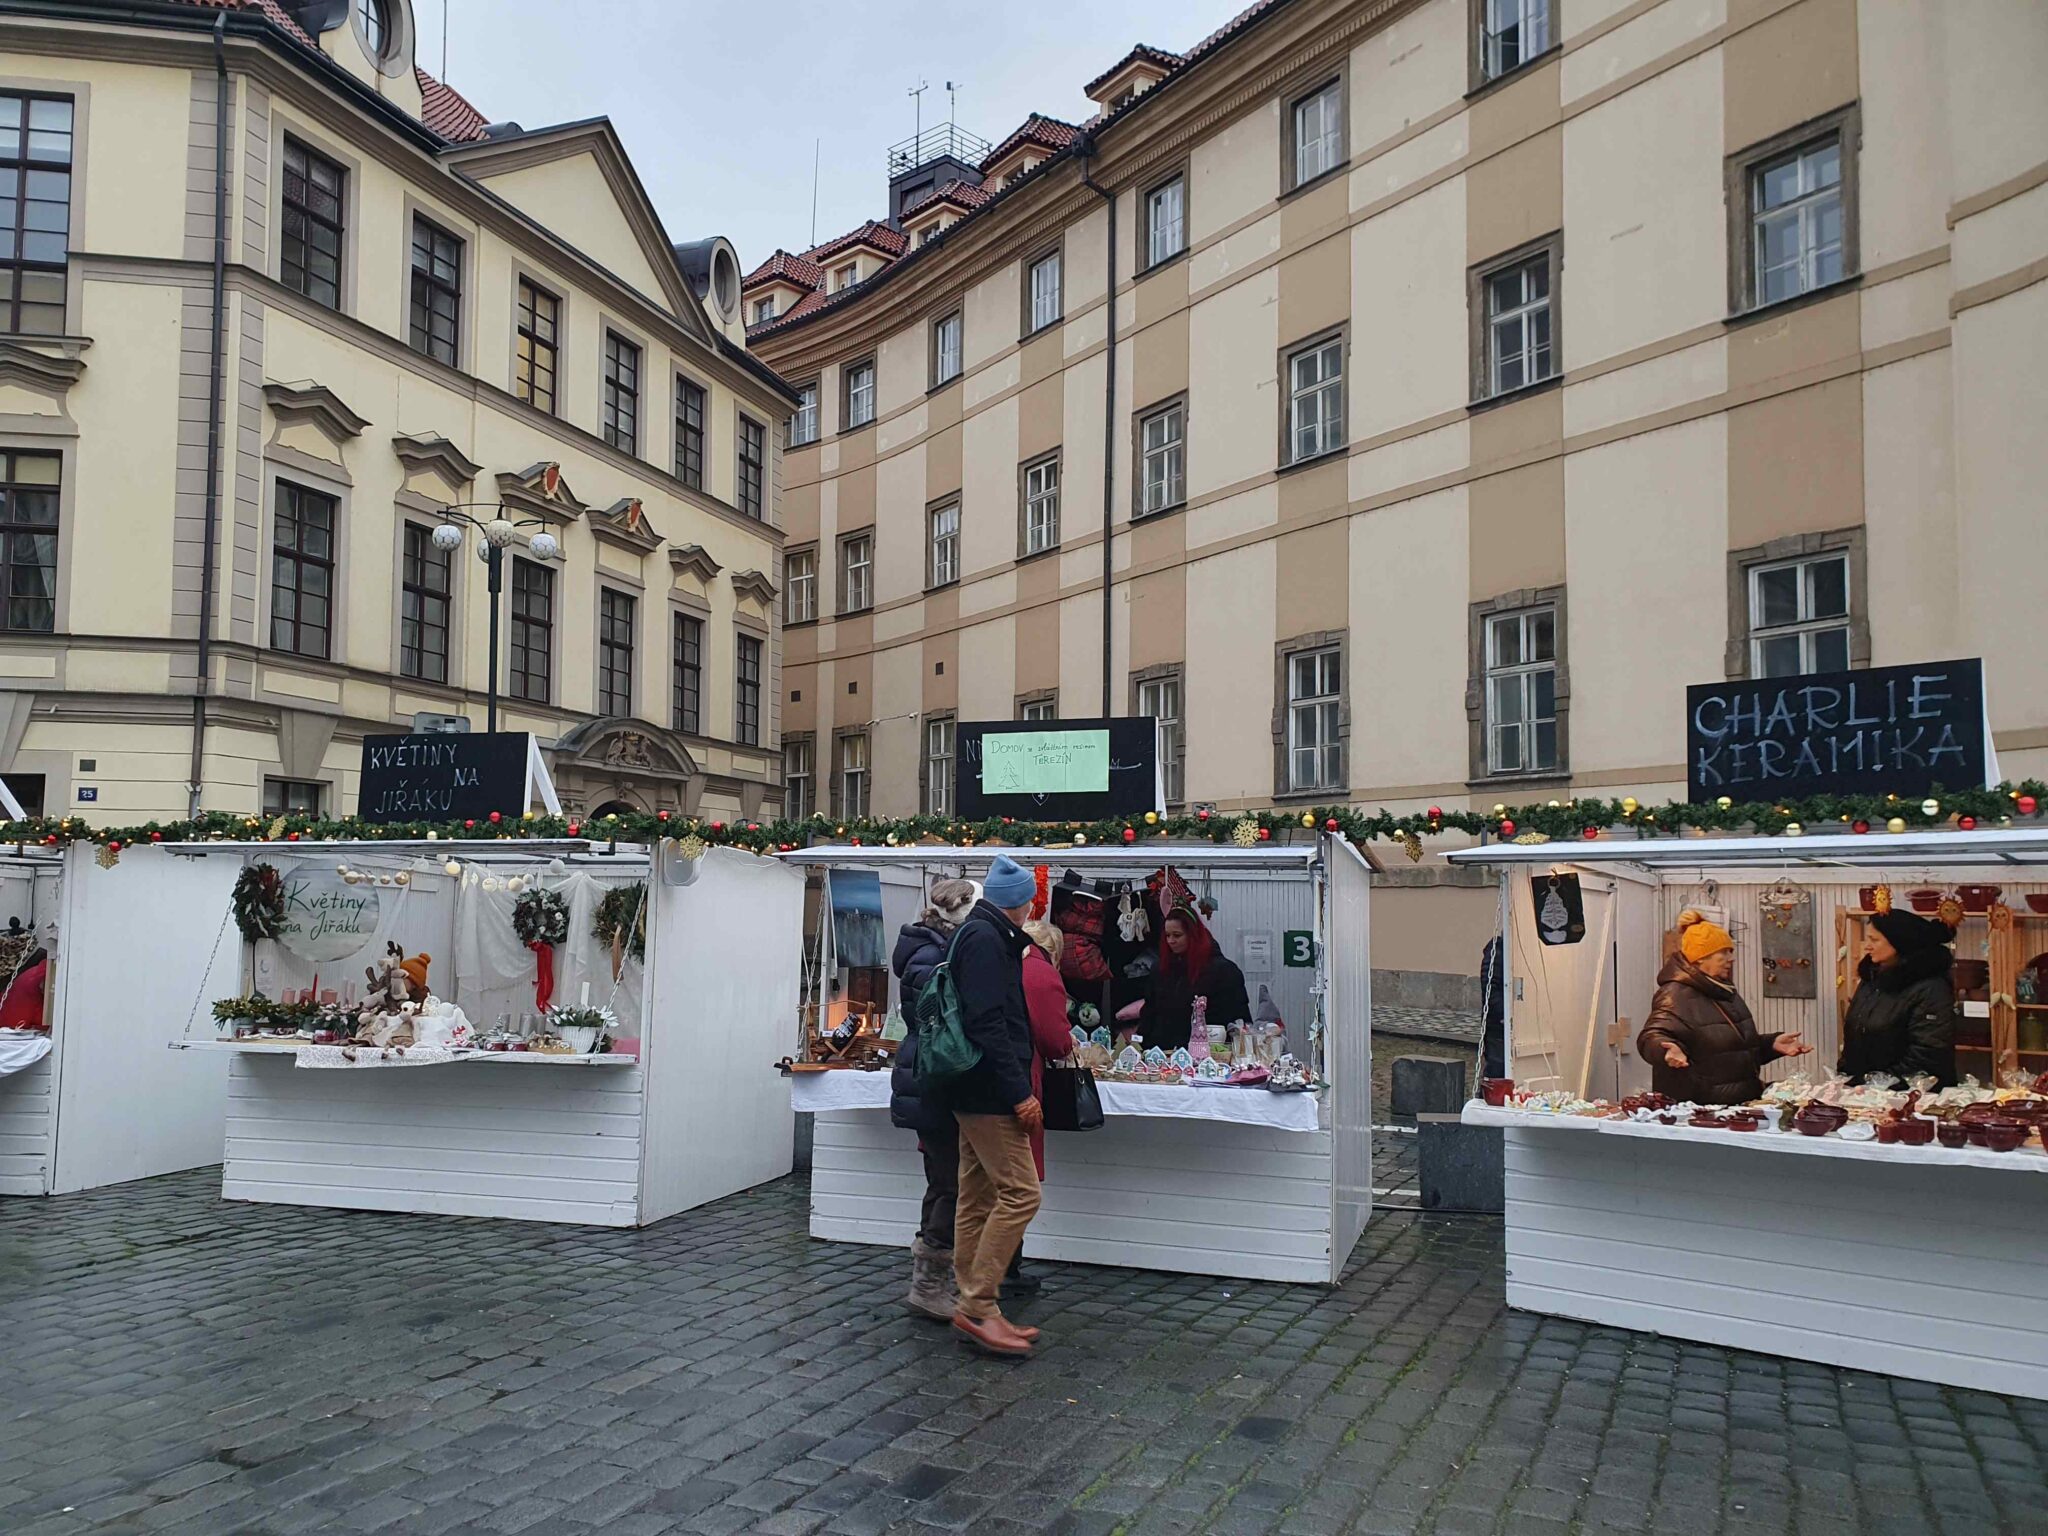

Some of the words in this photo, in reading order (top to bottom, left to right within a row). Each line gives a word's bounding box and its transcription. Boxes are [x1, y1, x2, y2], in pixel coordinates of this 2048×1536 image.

[1695, 674, 1952, 739] CHARLIE
[370, 736, 458, 770] KVĚTINY
[1697, 723, 1967, 787] KERAMIKA
[81, 790, 94, 798] 25
[453, 767, 480, 787] NA
[374, 779, 453, 814] JIŘÁKU
[287, 880, 367, 923] Květiny
[283, 923, 302, 933] na
[310, 911, 361, 941] Jiřáku
[1293, 936, 1311, 962] 3
